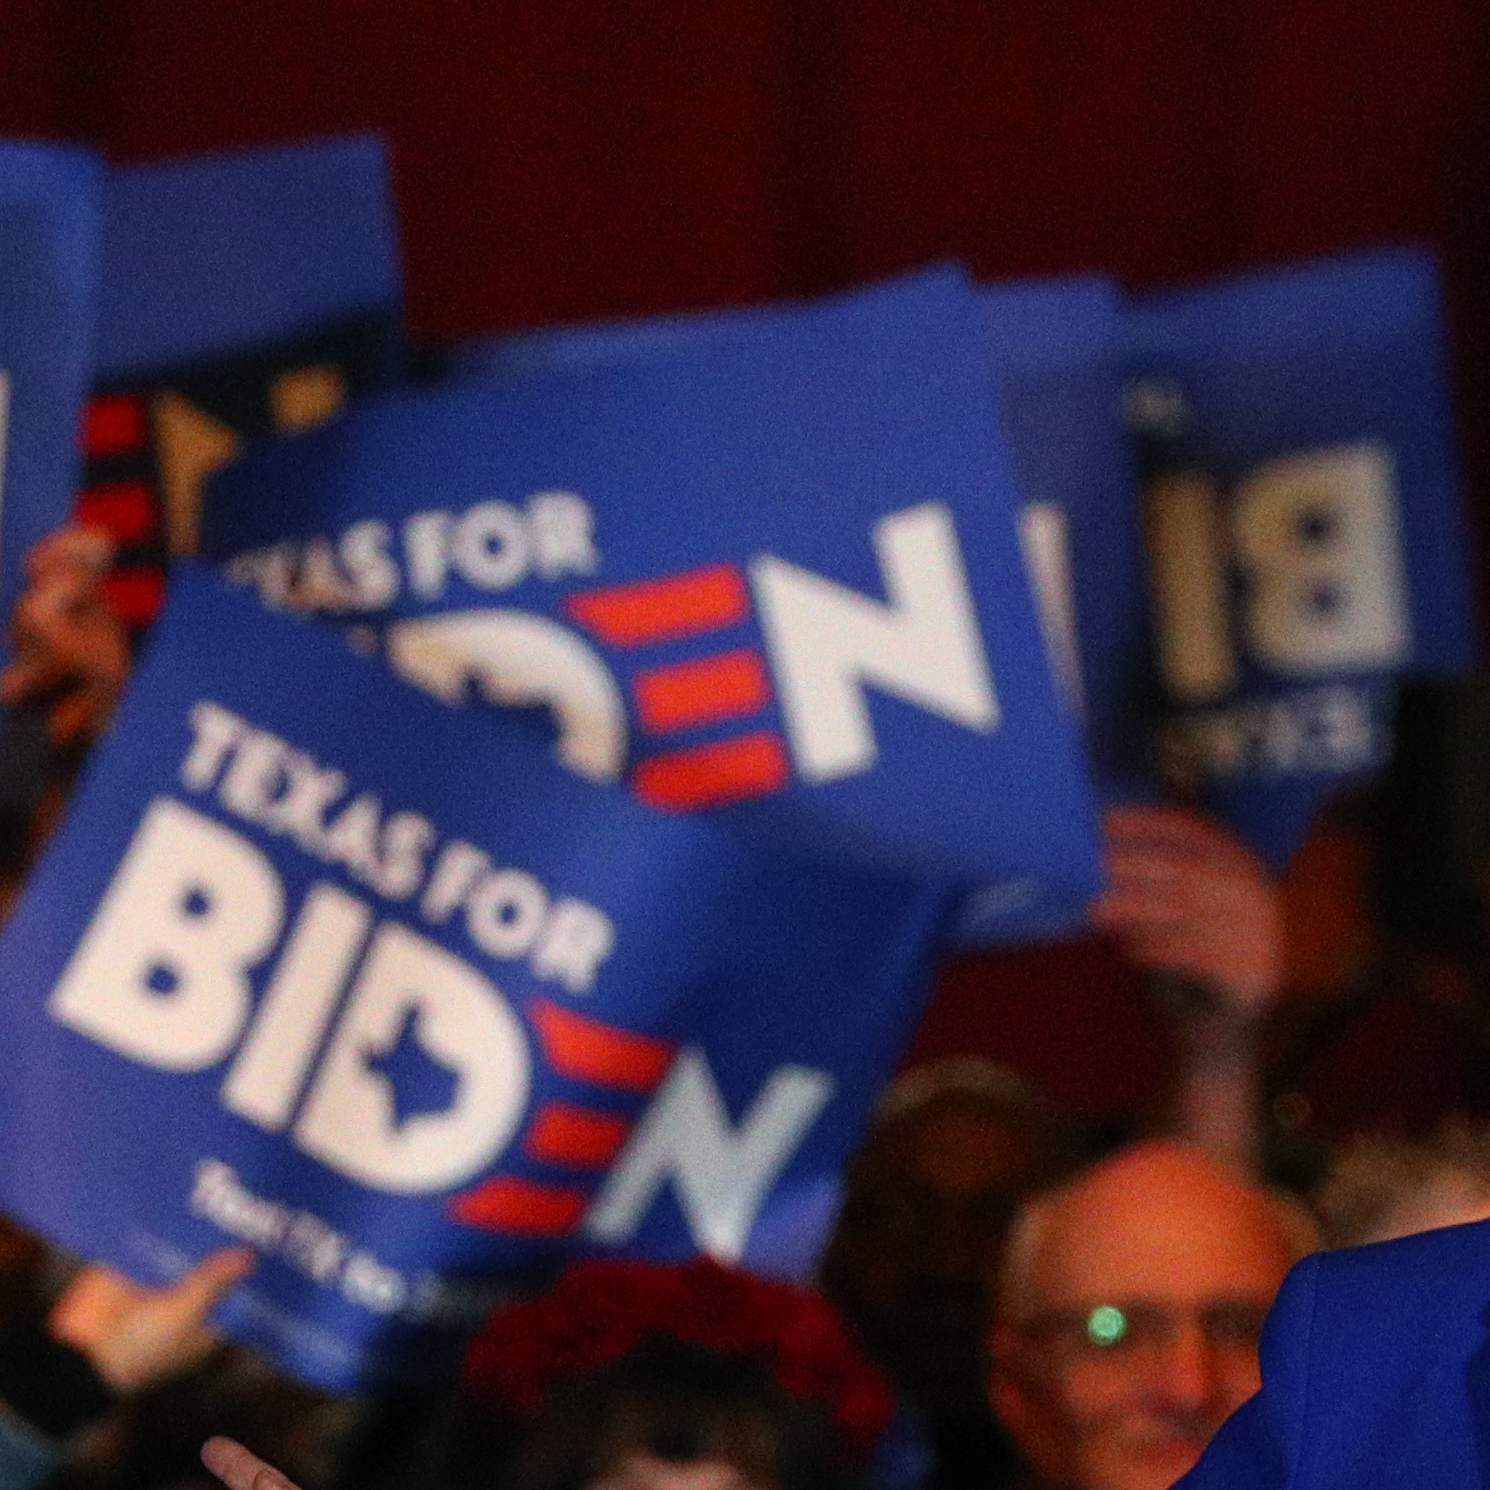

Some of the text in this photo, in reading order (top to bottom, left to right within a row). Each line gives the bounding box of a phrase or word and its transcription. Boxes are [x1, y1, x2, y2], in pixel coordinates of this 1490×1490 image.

[404, 489, 598, 601] FOR
[181, 700, 615, 994] TEXAS FOR
[48, 798, 835, 1264] BIDEN
